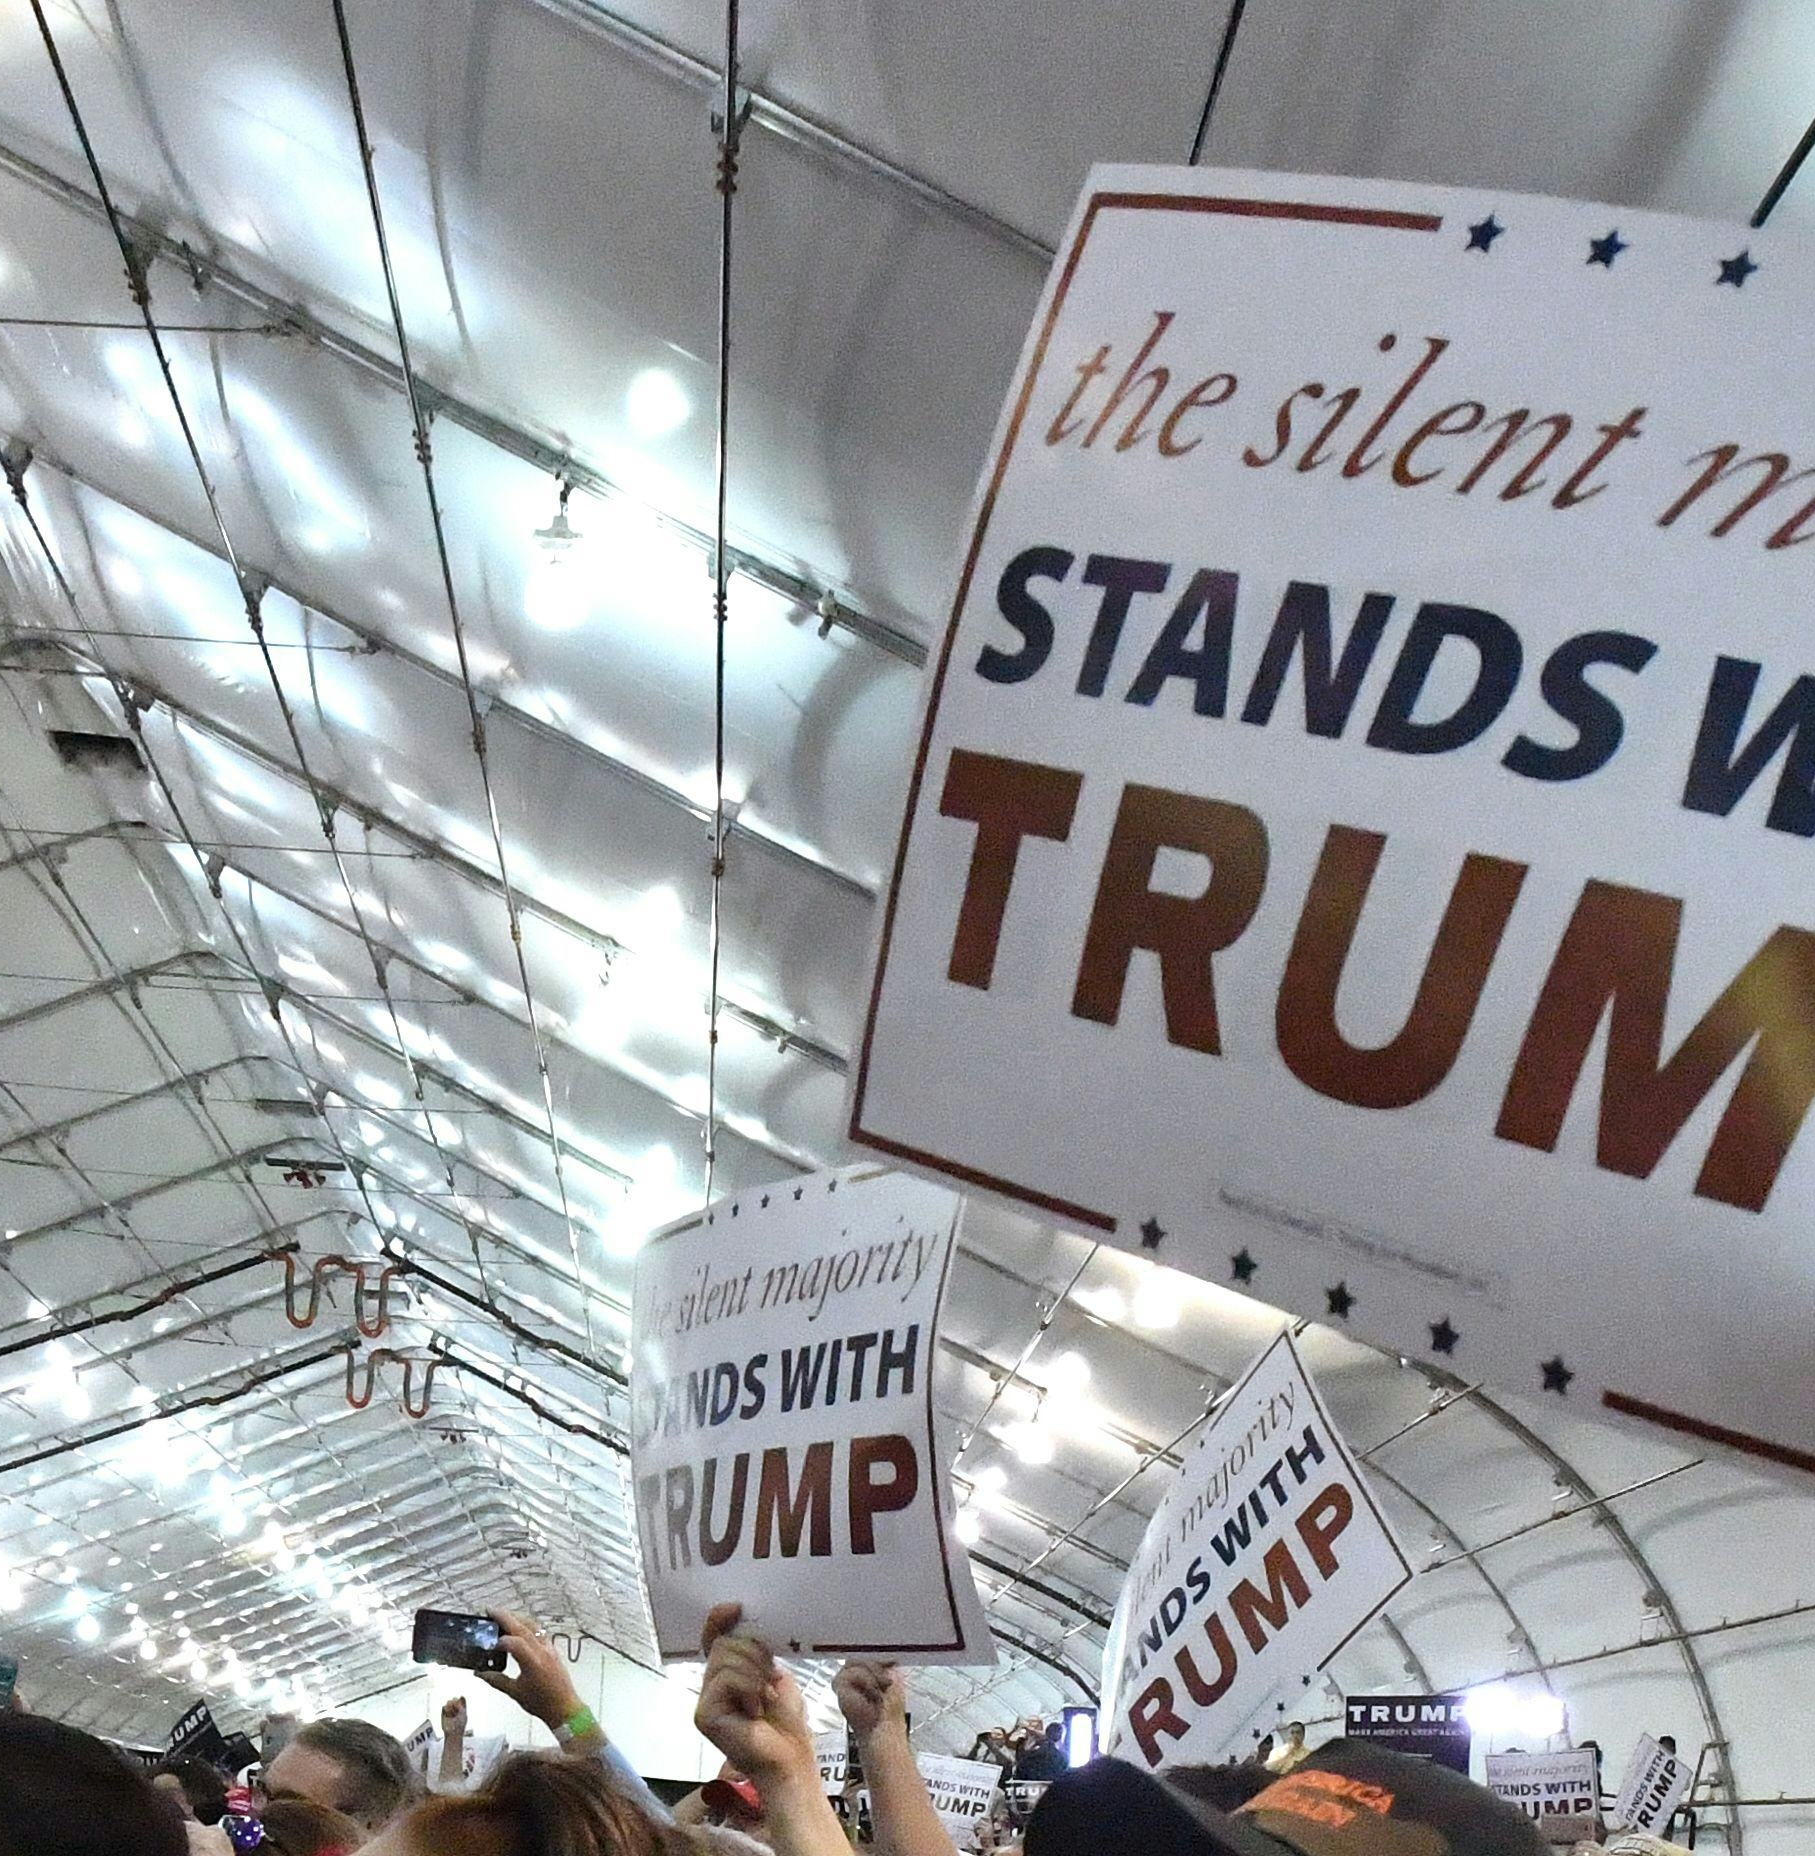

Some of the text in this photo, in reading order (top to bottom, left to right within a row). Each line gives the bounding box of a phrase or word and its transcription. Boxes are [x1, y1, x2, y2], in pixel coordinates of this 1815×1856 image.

[1045, 311, 1237, 457] the
[1244, 333, 1647, 509] silent
[975, 546, 1659, 783] STANDS
[760, 1214, 938, 1321] majority
[781, 1324, 920, 1413] WITH
[639, 1433, 919, 1577] TRUMP
[1182, 1382, 1296, 1541] majority
[1209, 1425, 1326, 1567] WITH
[1127, 1482, 1354, 1769] RUMP
[406, 1726, 434, 1753] UMP
[1545, 1780, 1592, 1795] WITH
[929, 1794, 987, 1818] UMP
[959, 1784, 991, 1800] WITH
[1521, 1797, 1594, 1821] UMP
[1637, 1758, 1678, 1829] RUMP
